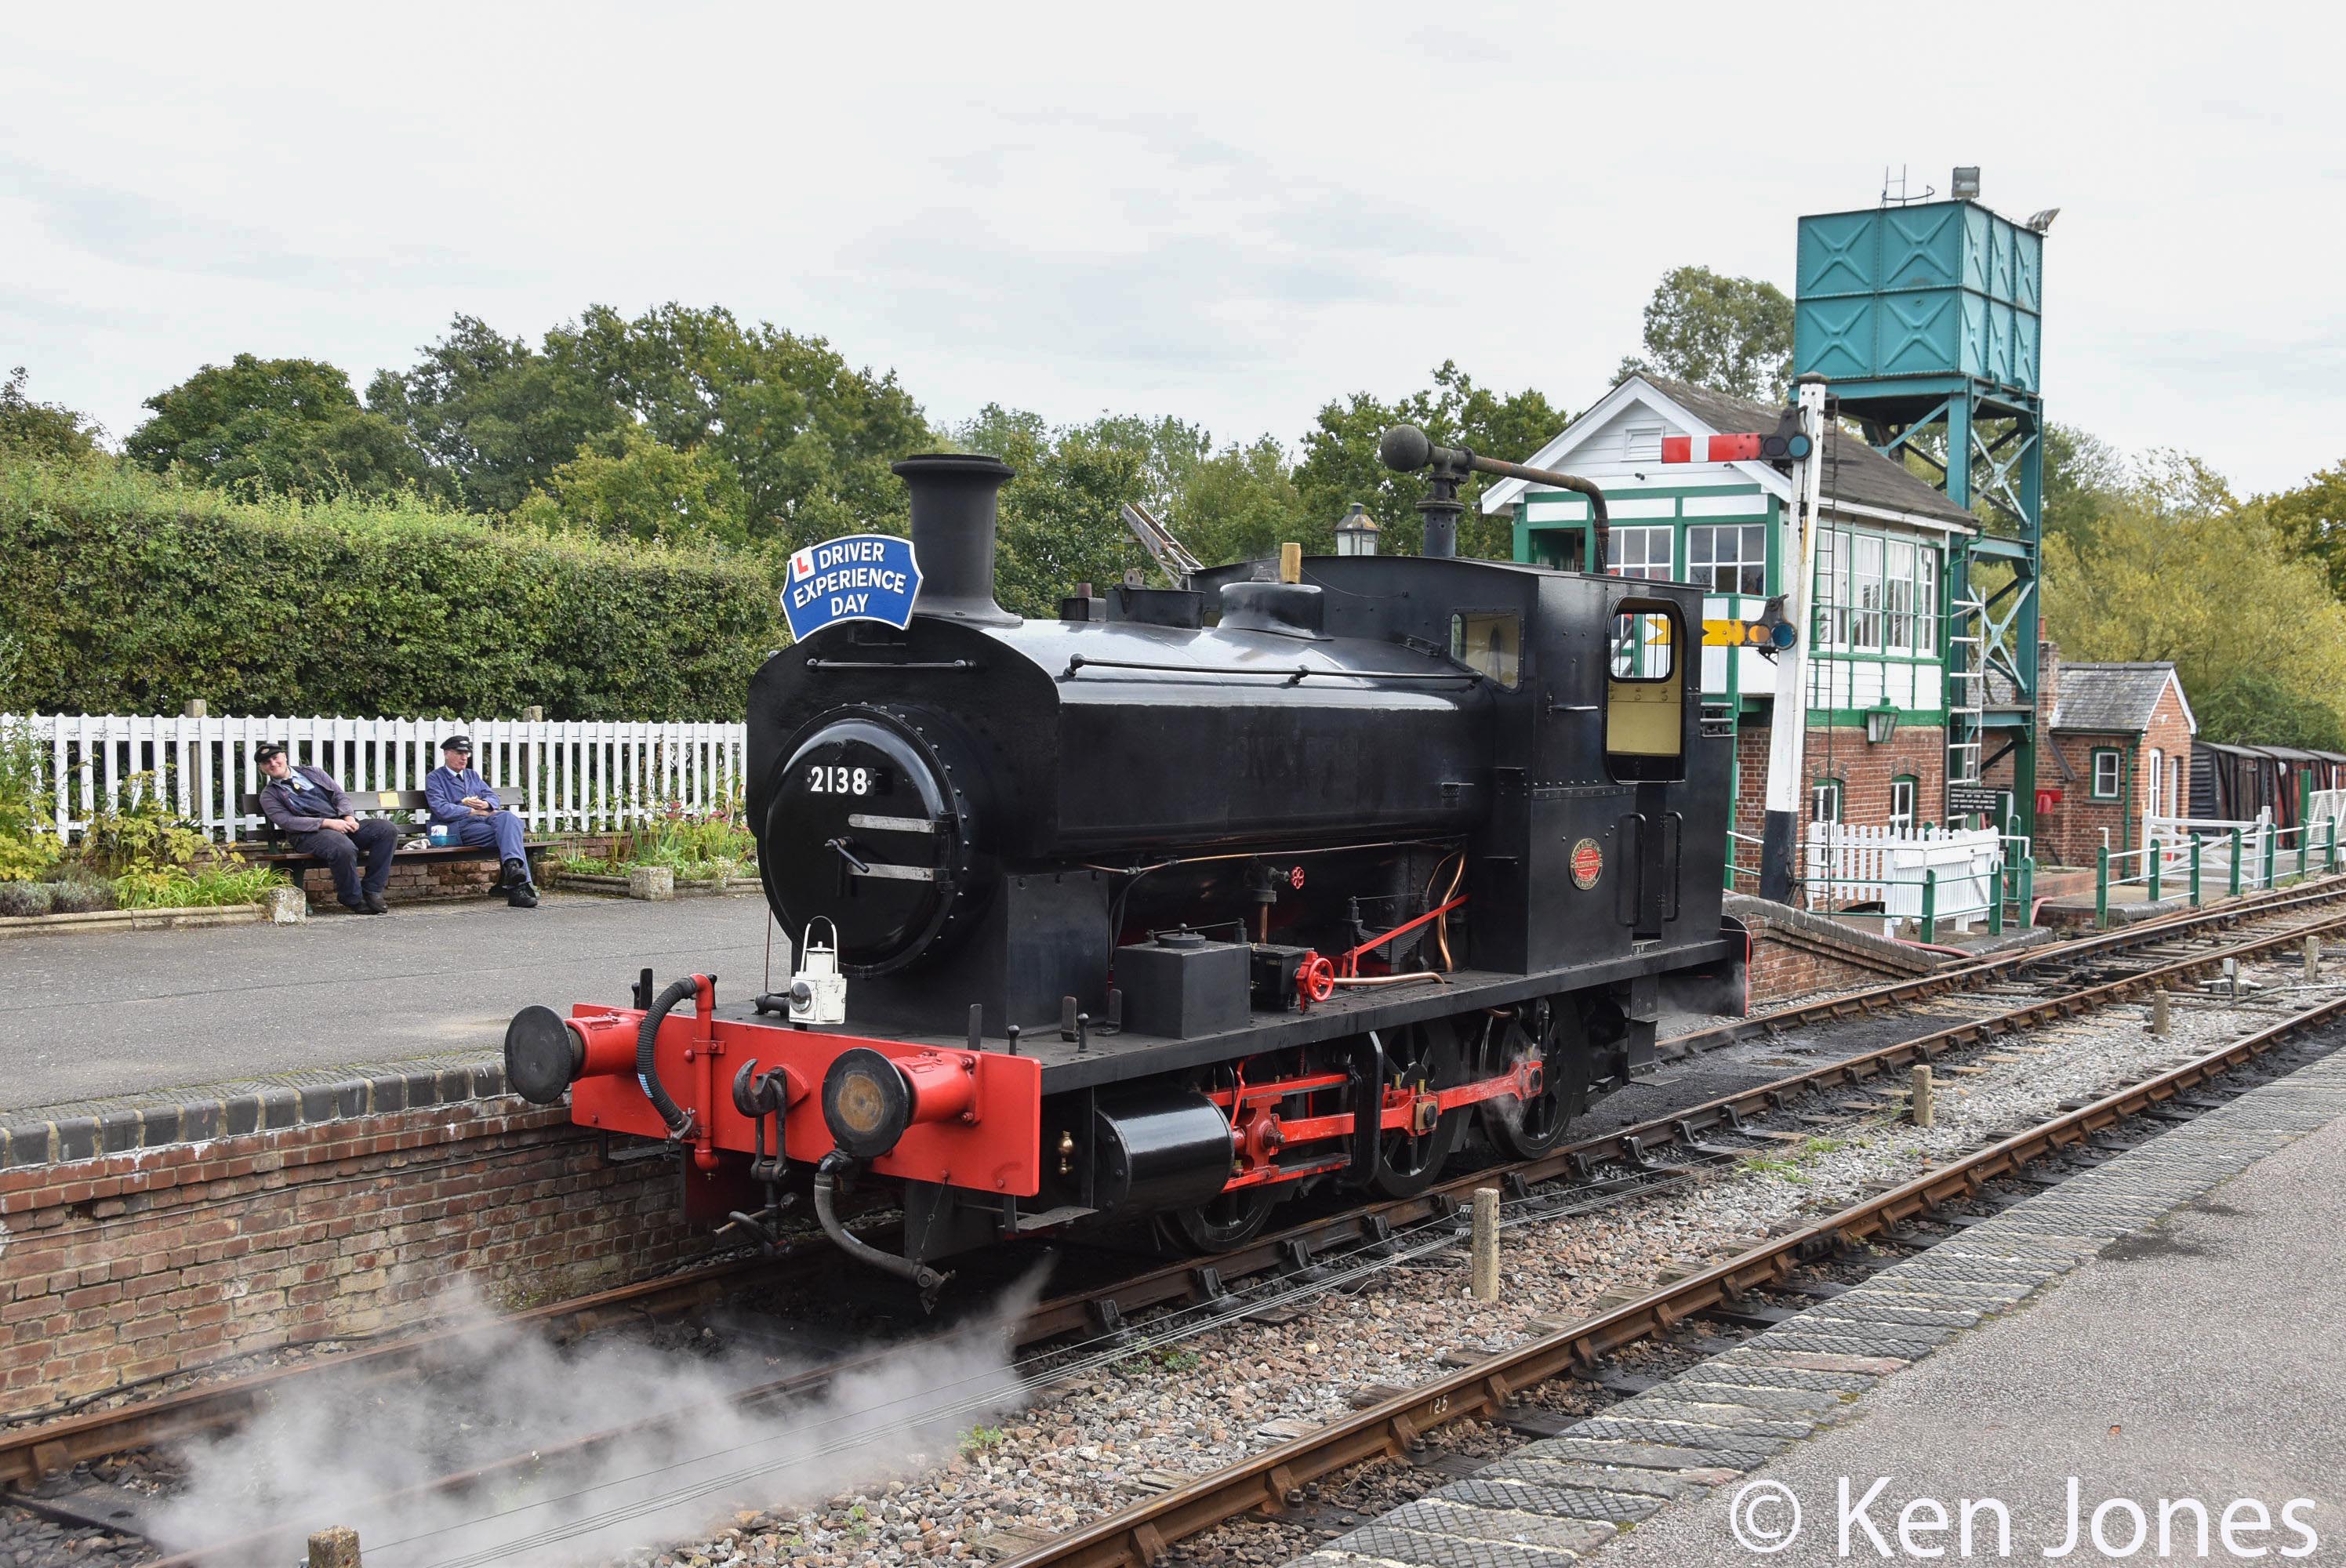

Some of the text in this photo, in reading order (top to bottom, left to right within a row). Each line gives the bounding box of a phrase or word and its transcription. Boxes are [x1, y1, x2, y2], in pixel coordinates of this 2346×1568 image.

[796, 557, 808, 575] L
[819, 542, 884, 569] DRIVER
[794, 568, 906, 608] EXPERIENCE
[831, 593, 869, 617] DAY
[810, 766, 867, 795] 2138
